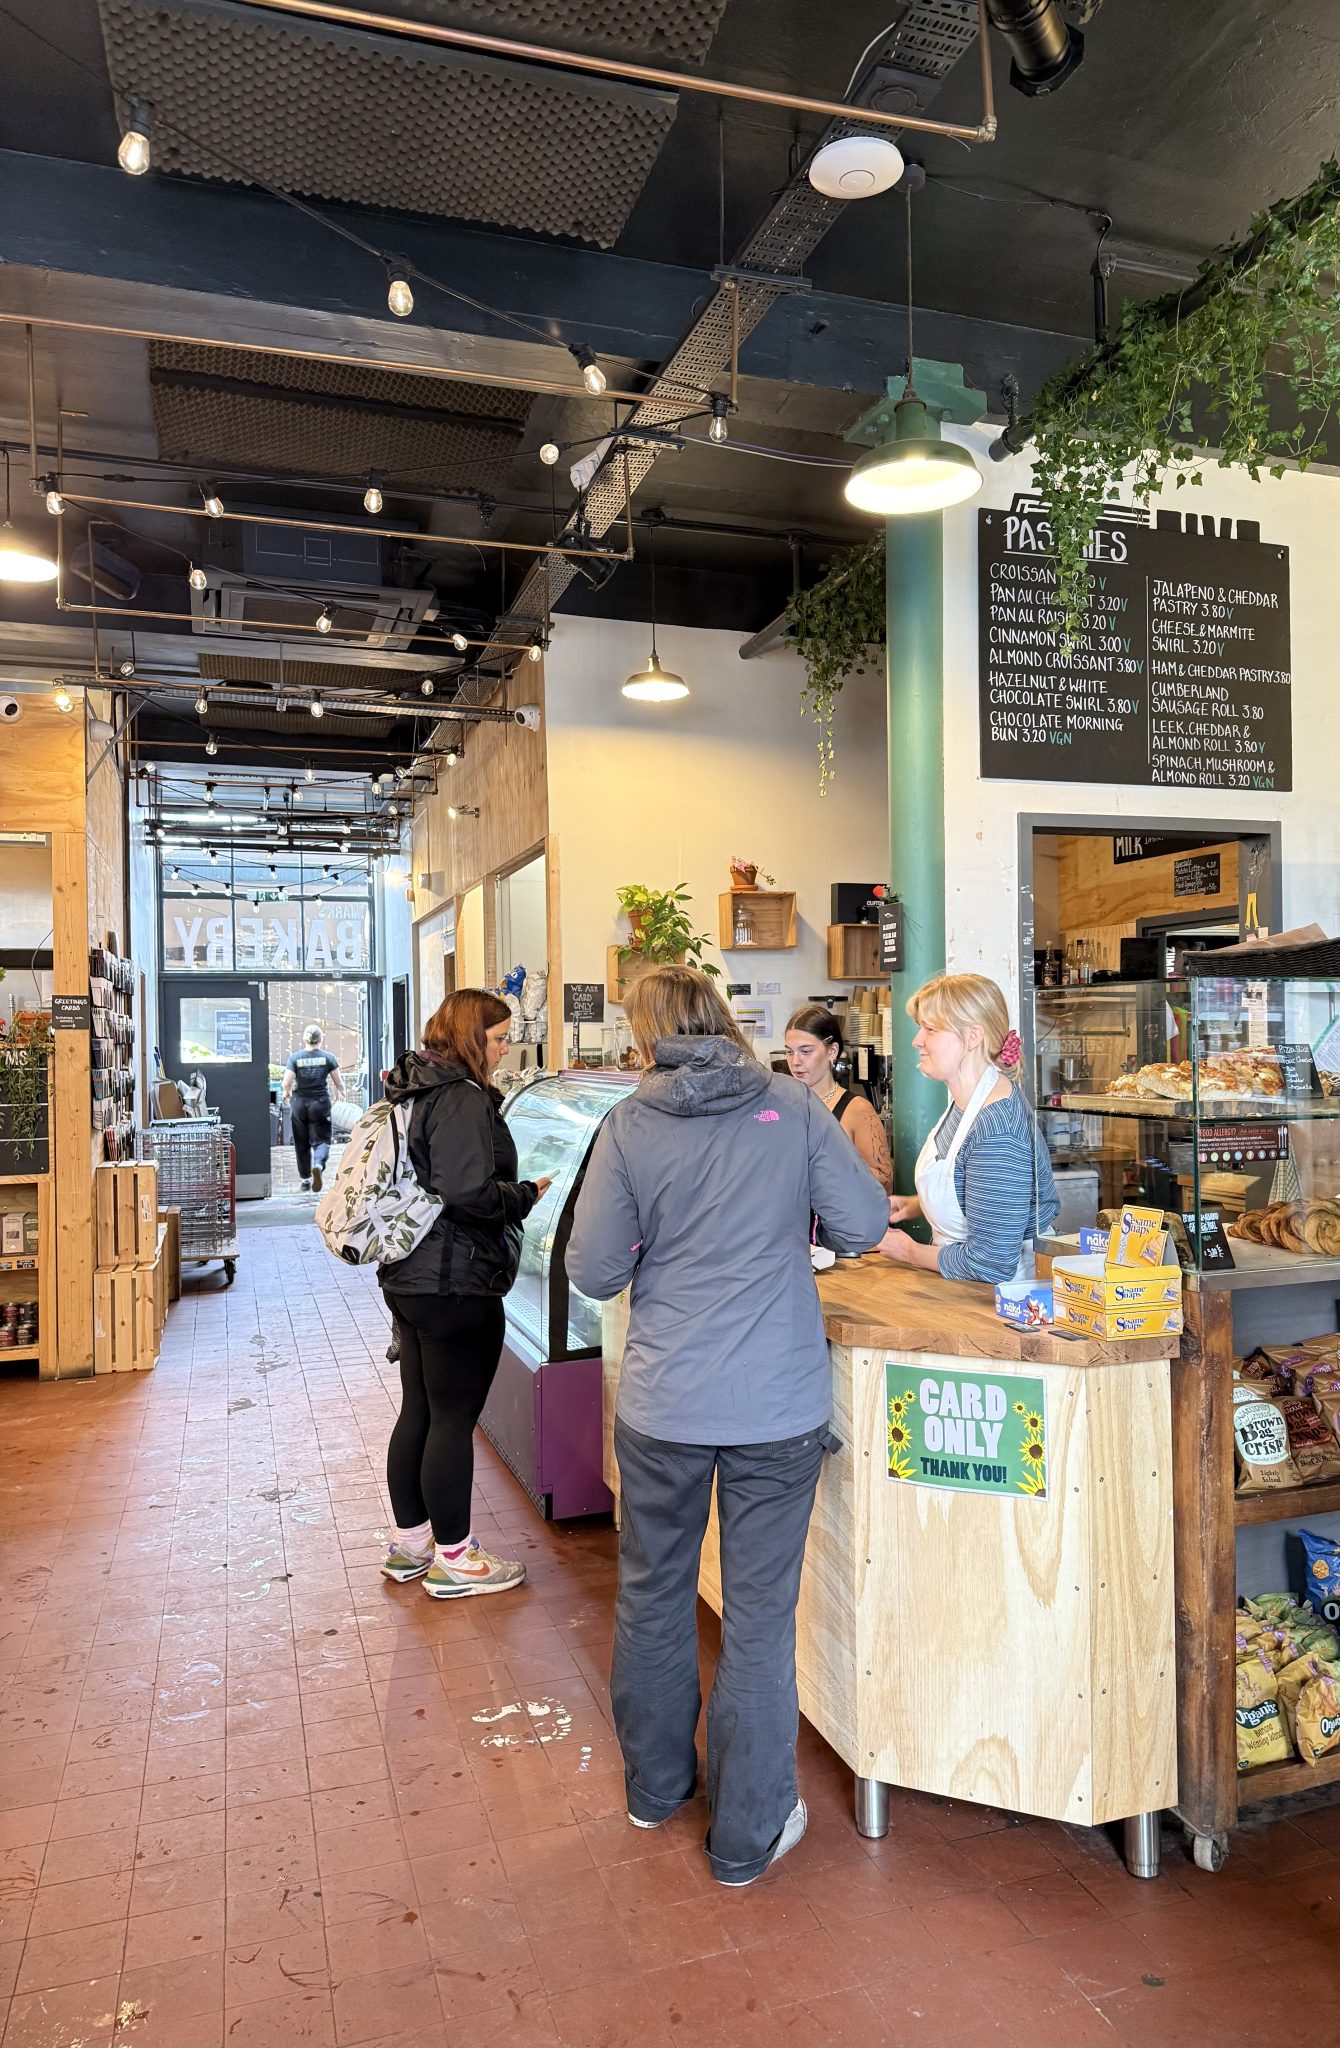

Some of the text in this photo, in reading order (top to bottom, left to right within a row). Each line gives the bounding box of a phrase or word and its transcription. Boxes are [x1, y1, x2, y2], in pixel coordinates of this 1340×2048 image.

[1099, 577, 1107, 591] V
[1153, 580, 1279, 609] JALAPENO & CHEDDAR
[990, 583, 1016, 603] PAN
[1018, 588, 1032, 604] AU
[1098, 597, 1121, 611] 3.20
[1121, 598, 1129, 612] V
[1152, 597, 1234, 620] PASTRY 3.80 V
[990, 605, 1017, 622] PAN
[1019, 609, 1036, 624] AU
[1081, 614, 1106, 630] 3.20
[1109, 617, 1116, 631] V
[1152, 618, 1255, 641] CHEESE & MARMITE
[989, 626, 1131, 653] CINNAMON SWIRL 3.00 V
[1152, 636, 1225, 657] SWIRL 3.20 V
[989, 648, 1144, 674] ALMOND CROISSANT 3.80 V
[1151, 659, 1291, 684] HAM & CHEDDAR PASTRY 3.80
[988, 670, 1108, 694] HAZELNUT & WHITE
[1152, 682, 1229, 701] CUMBERLAND
[990, 688, 1139, 715] CHOCOLATE SWIRL 3.80 V
[1152, 697, 1264, 720] SAUSAGE ROLL 3.80
[990, 711, 1124, 731] CHOCOLATE MORNING
[1188, 721, 1241, 738] CHEDDAR
[1243, 725, 1251, 738] &
[991, 727, 1072, 745] BUN 3.20 VGN
[1152, 735, 1266, 754] ALMOND ROLL 3.80 V
[1206, 757, 1266, 773] MUSHROOM
[1267, 761, 1276, 773] &
[1152, 769, 1275, 788] ALMOND ROLL 3.20 VGN
[1116, 836, 1143, 857] MILK
[572, 992, 593, 1002] CARD
[573, 1001, 594, 1010] ONLY
[919, 1378, 1007, 1421] CARD
[924, 1415, 1003, 1459] ONLY
[920, 1457, 1007, 1483] THANK YOU!
